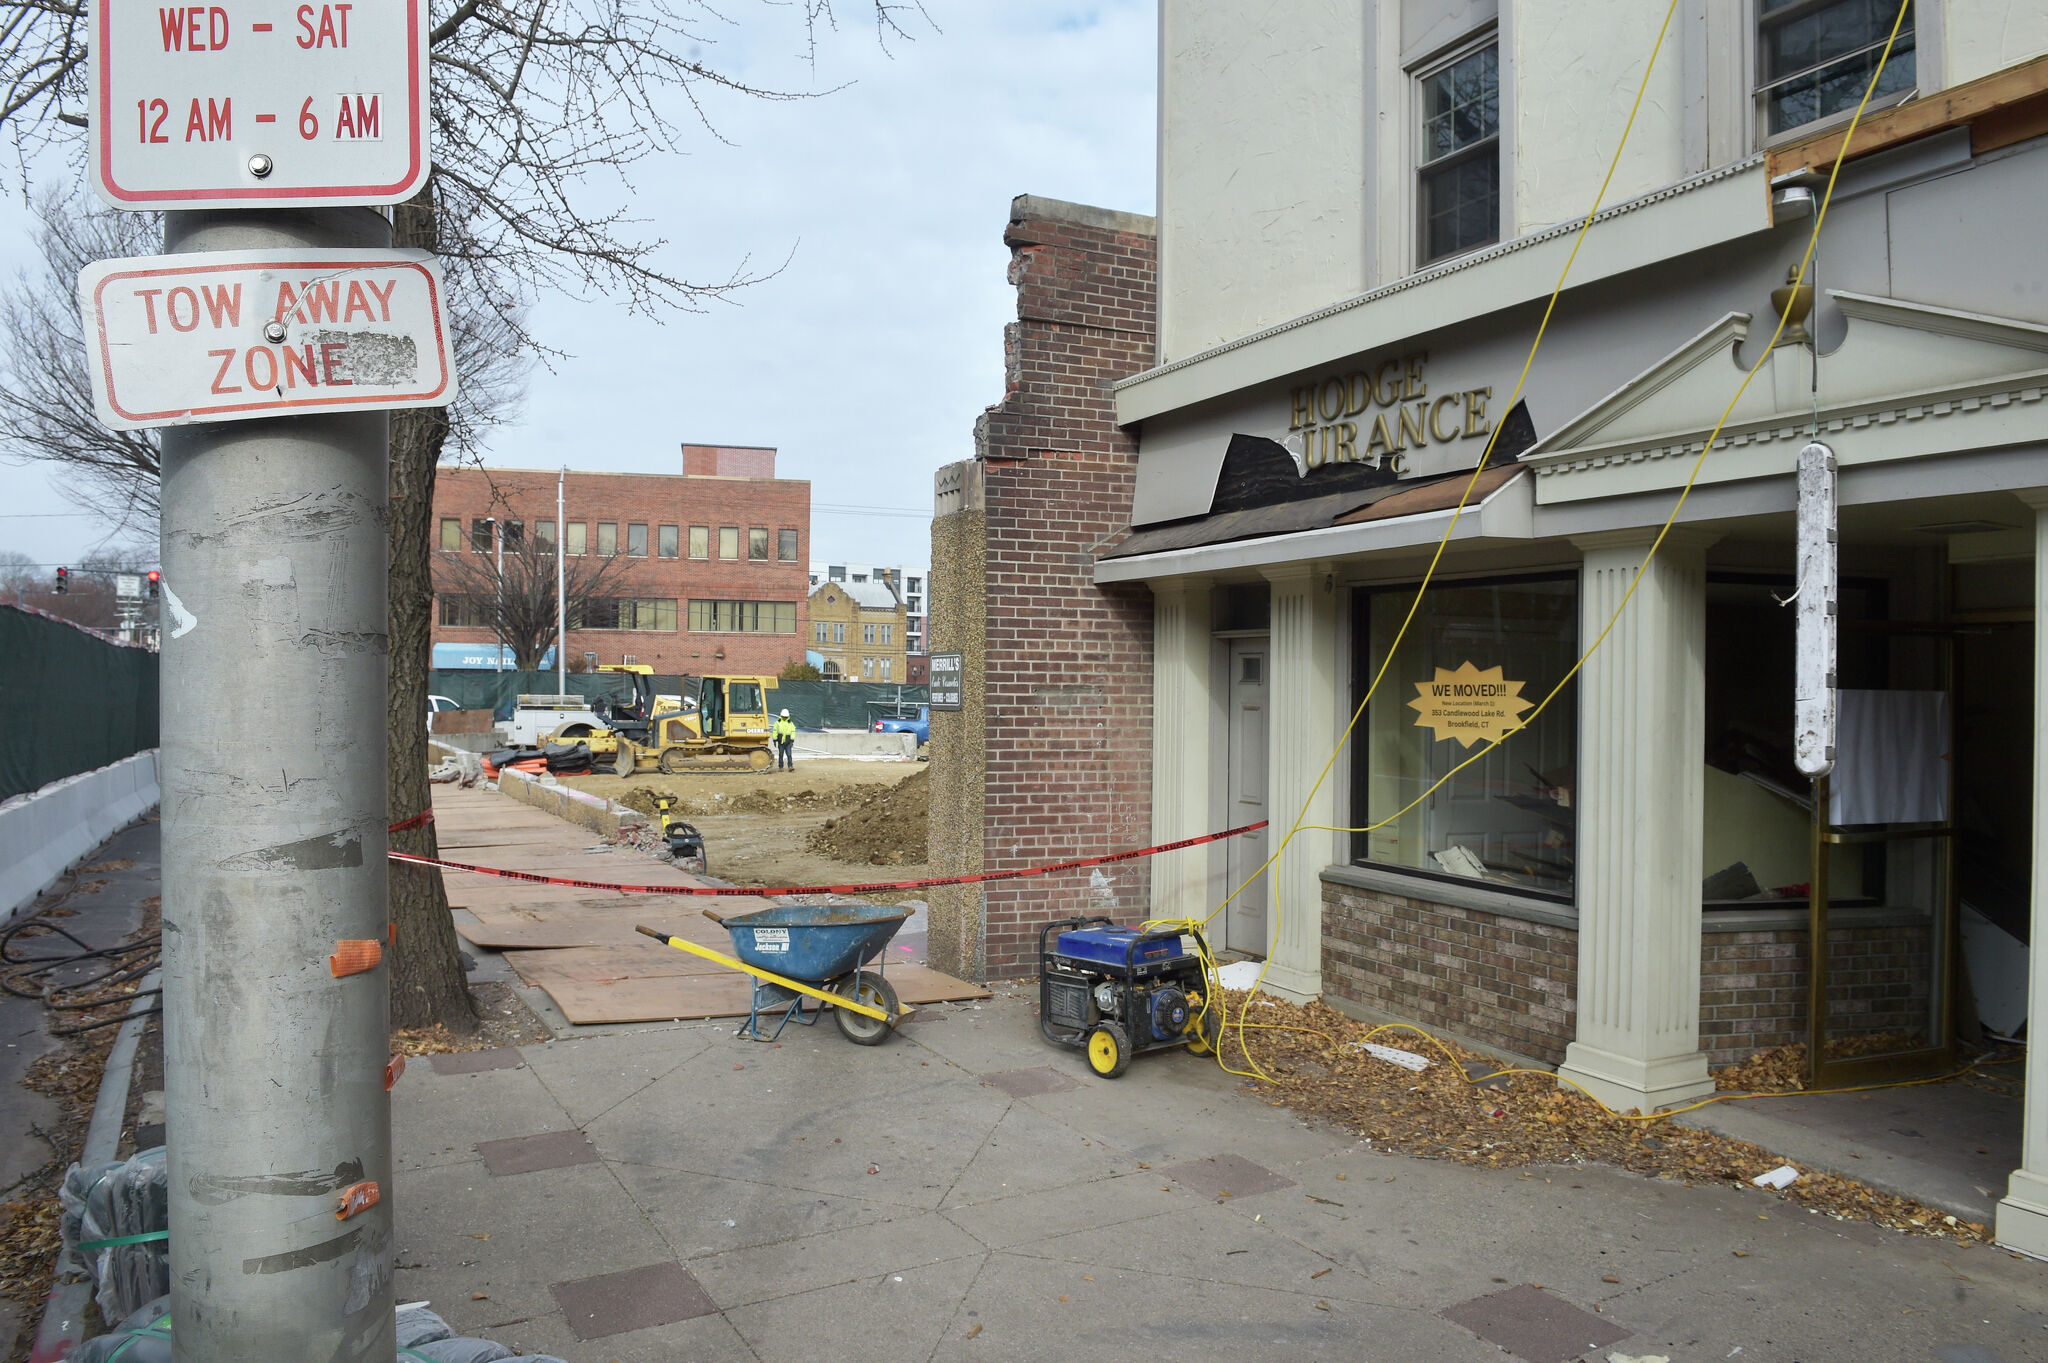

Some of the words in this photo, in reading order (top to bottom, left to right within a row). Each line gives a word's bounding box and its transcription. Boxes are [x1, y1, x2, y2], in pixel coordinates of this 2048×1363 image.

[159, 7, 230, 52] WED
[296, 4, 352, 49] SAT
[137, 97, 169, 143] 12
[186, 97, 231, 142] AM
[299, 96, 319, 140] 6
[336, 95, 380, 139] AM
[134, 283, 242, 335] TOW
[273, 279, 396, 326] AWAY
[208, 343, 353, 395] ZONE
[1288, 352, 1427, 431] HODGE
[462, 656, 484, 665] JOY
[486, 656, 516, 666] NIL
[1432, 684, 1451, 697] WE
[1453, 684, 1507, 697] MOVED!!!
[1443, 709, 1479, 717] Candlewood
[1448, 720, 1480, 728] Brookfield,
